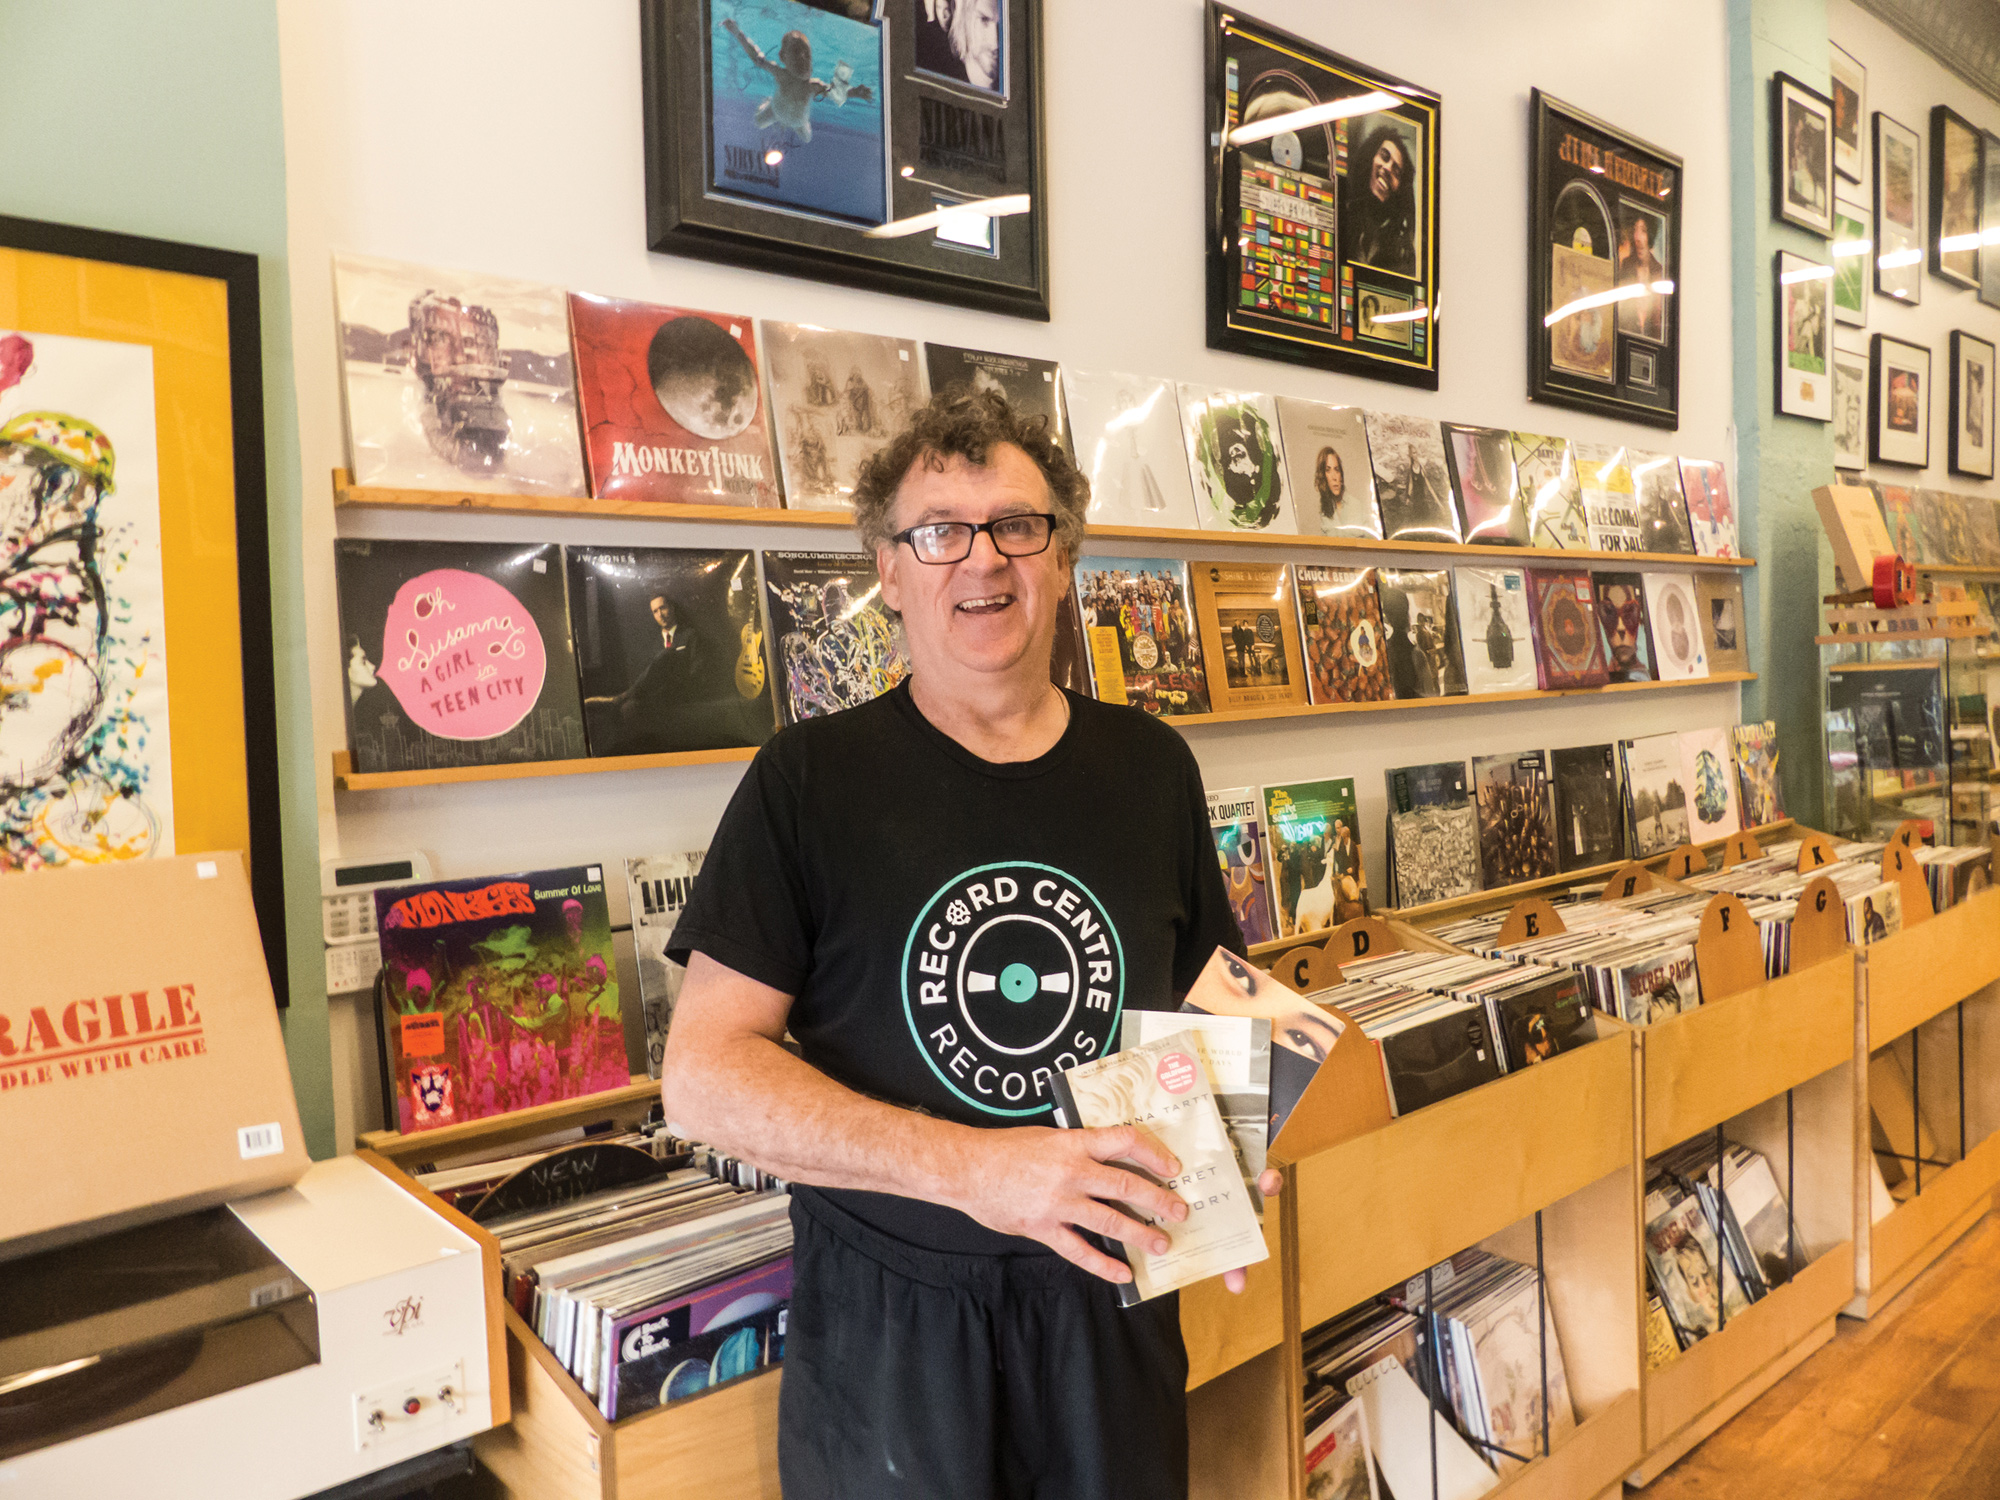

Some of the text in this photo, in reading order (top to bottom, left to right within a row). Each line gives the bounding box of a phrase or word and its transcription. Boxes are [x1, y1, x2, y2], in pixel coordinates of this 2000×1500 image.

[1599, 534, 1621, 552] FOR
[1298, 569, 1330, 582] CHUCK
[414, 587, 455, 621] Oh
[398, 616, 525, 671] Susanna
[420, 650, 475, 693] A GIRL
[475, 664, 498, 682] in
[431, 676, 524, 717] TEEN CITY
[1273, 790, 1288, 799] The
[1220, 801, 1255, 819] QUARTET
[1812, 846, 1824, 866] K
[534, 883, 602, 900] Summer Of Love
[1815, 890, 1826, 912] G
[394, 881, 537, 930] MONKEES
[1525, 913, 1539, 937] E
[1033, 879, 1112, 1012] CENTRE
[1353, 930, 1369, 956] D
[1294, 958, 1309, 988] C
[1629, 967, 1664, 998] SECRET
[60, 1052, 132, 1079] WITH
[140, 1037, 207, 1065] CARE
[1211, 1048, 1243, 1057] WORLD
[1163, 1093, 1209, 1114] TARTT
[531, 1153, 597, 1191] NEW
